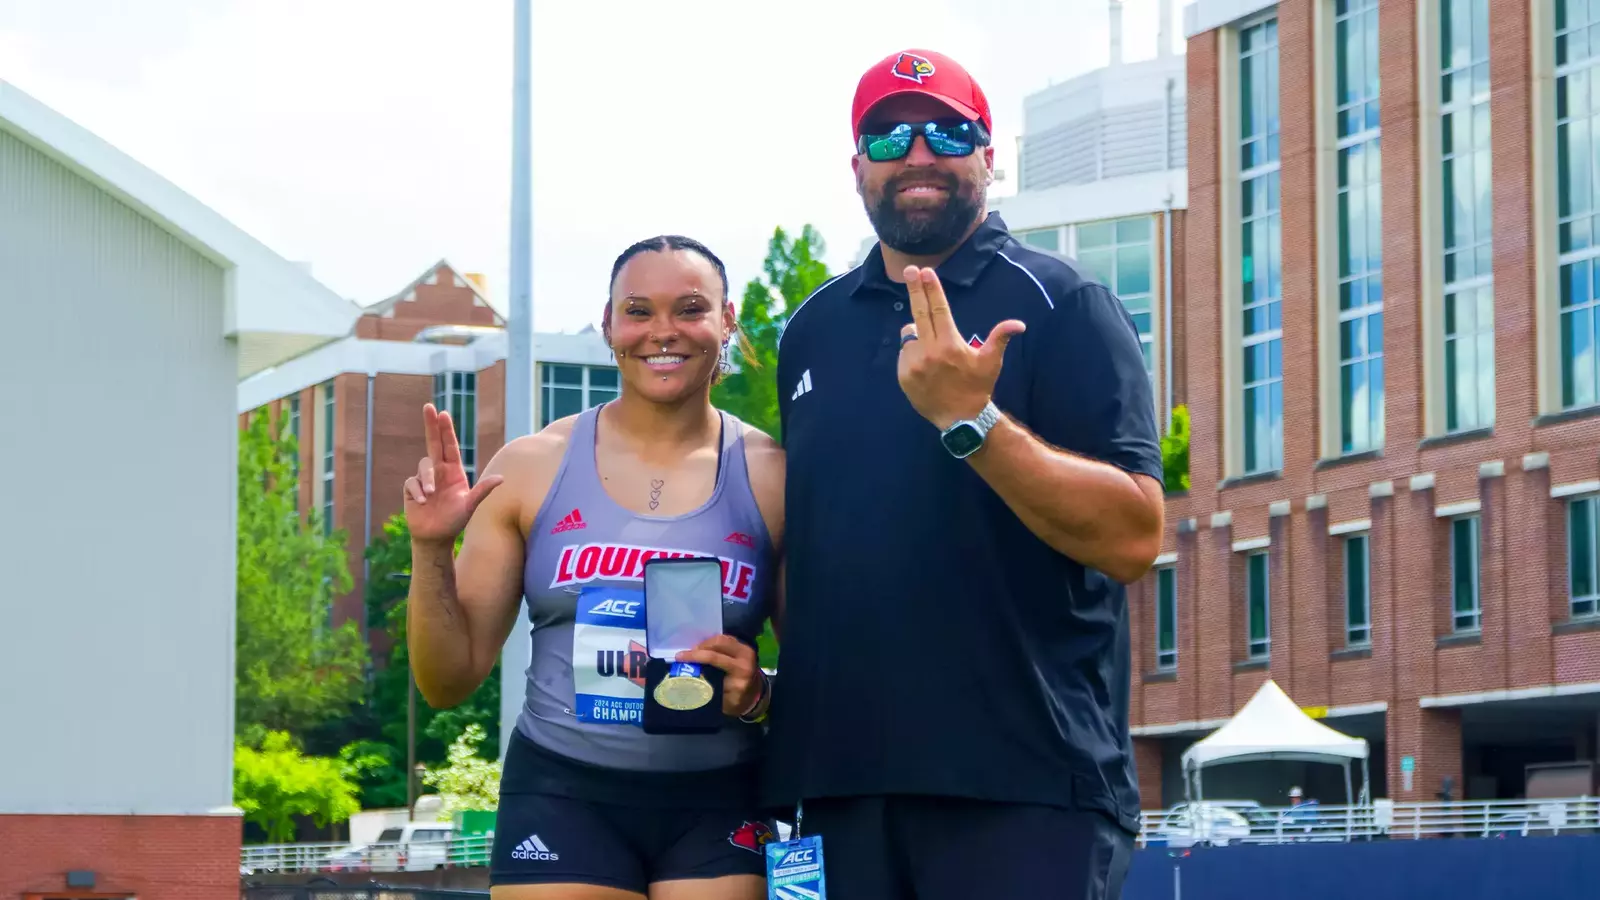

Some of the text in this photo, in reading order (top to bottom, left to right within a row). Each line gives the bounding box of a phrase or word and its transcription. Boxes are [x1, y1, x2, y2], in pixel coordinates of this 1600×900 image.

[551, 544, 755, 603] LOUISLE
[589, 599, 641, 616] ACC
[594, 699, 609, 707] 2024
[611, 701, 622, 709] ACC
[593, 706, 642, 722] CHAMPI
[511, 850, 559, 861] adidas
[780, 849, 814, 866] ACC
